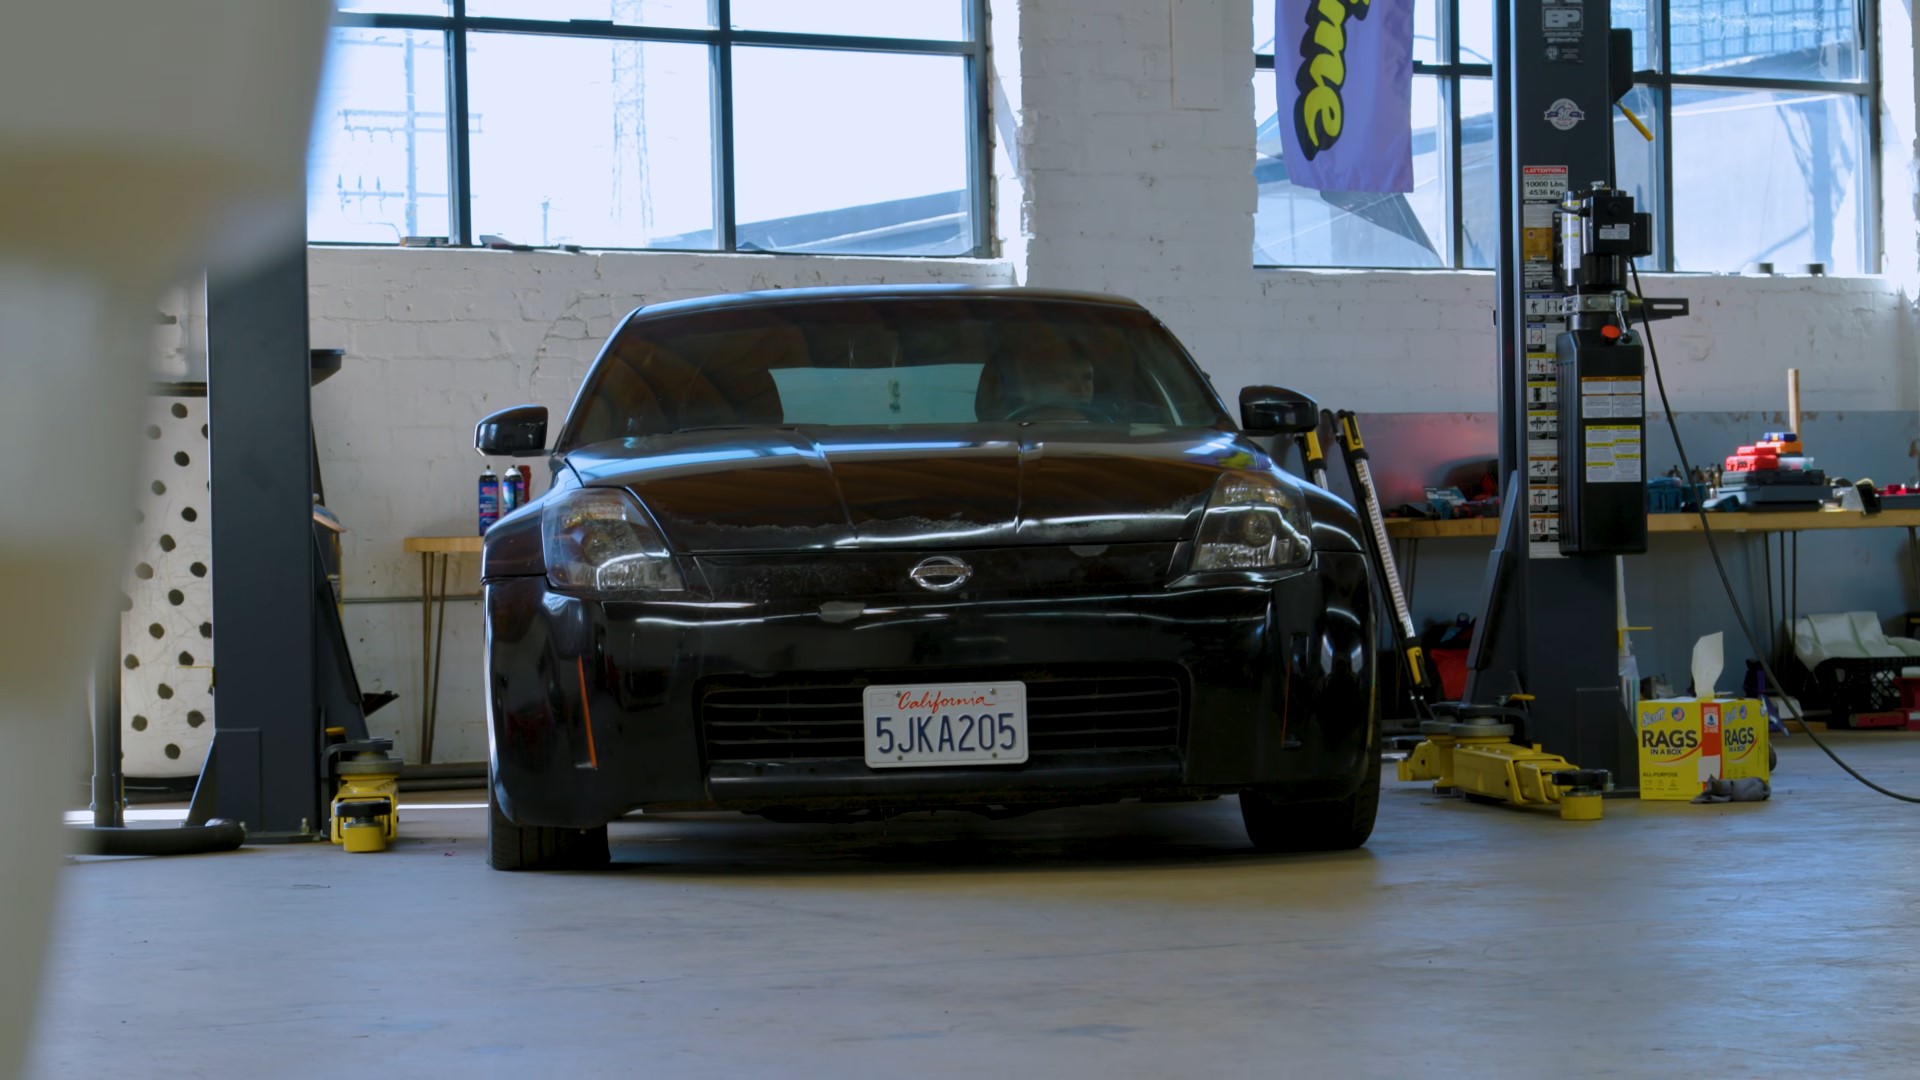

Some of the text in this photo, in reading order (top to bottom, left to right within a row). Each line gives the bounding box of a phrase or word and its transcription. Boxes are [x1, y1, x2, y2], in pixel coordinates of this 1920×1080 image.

[898, 691, 996, 714] California
[876, 713, 1016, 754] 5JKA205
[1642, 729, 1699, 748] RAGS
[1724, 726, 1755, 747] RAGS
